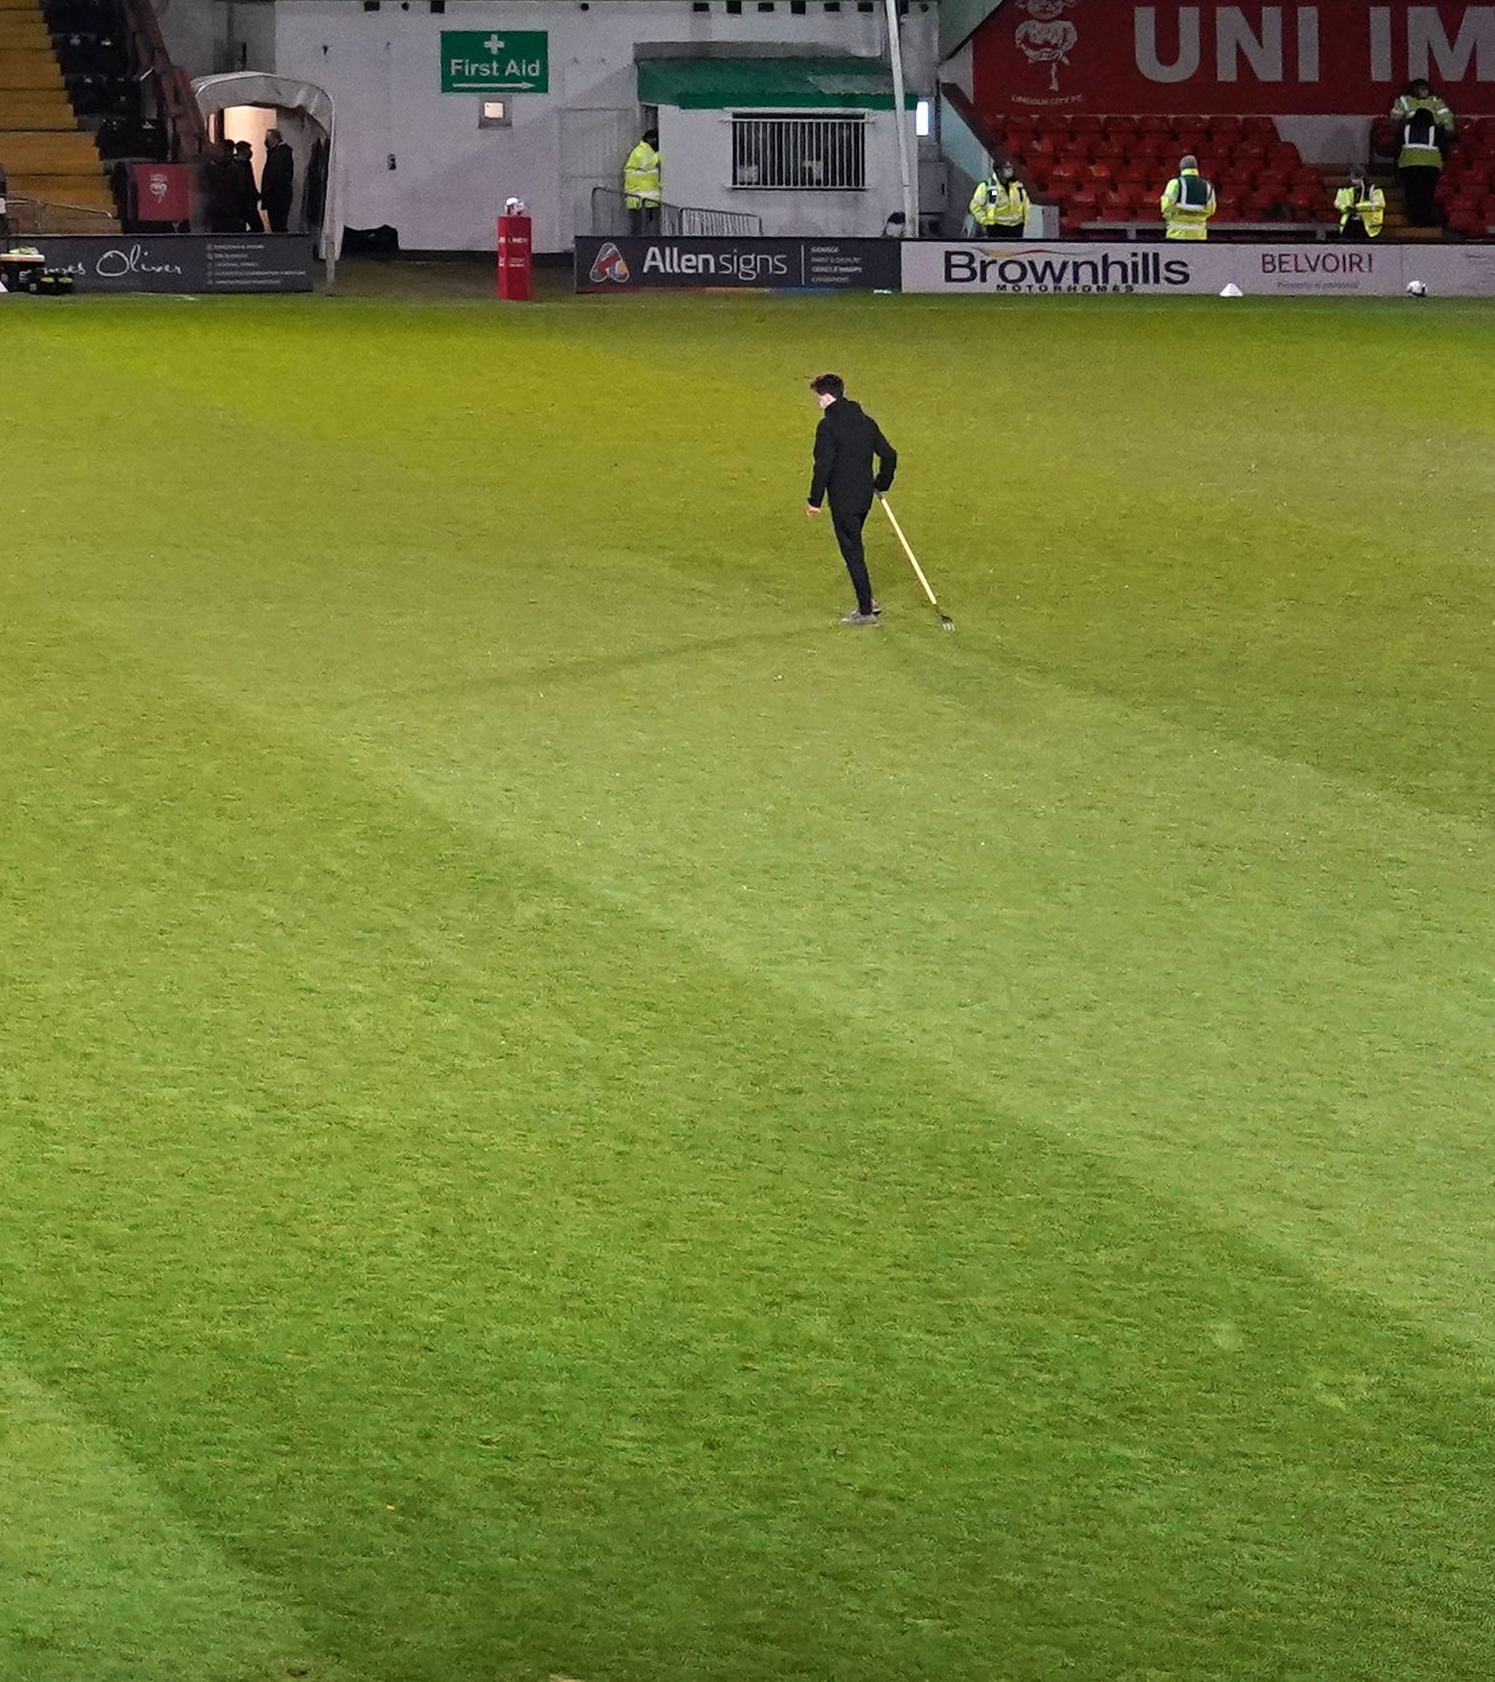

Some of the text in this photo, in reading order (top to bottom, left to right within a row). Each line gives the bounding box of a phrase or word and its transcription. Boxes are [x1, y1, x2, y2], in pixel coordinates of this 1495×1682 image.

[1134, 5, 1320, 83] UNI
[450, 58, 540, 77] First Aid
[95, 243, 183, 277] Oliver
[943, 250, 1191, 285] Brownhills
[996, 283, 1135, 293] MOTORHOMES
